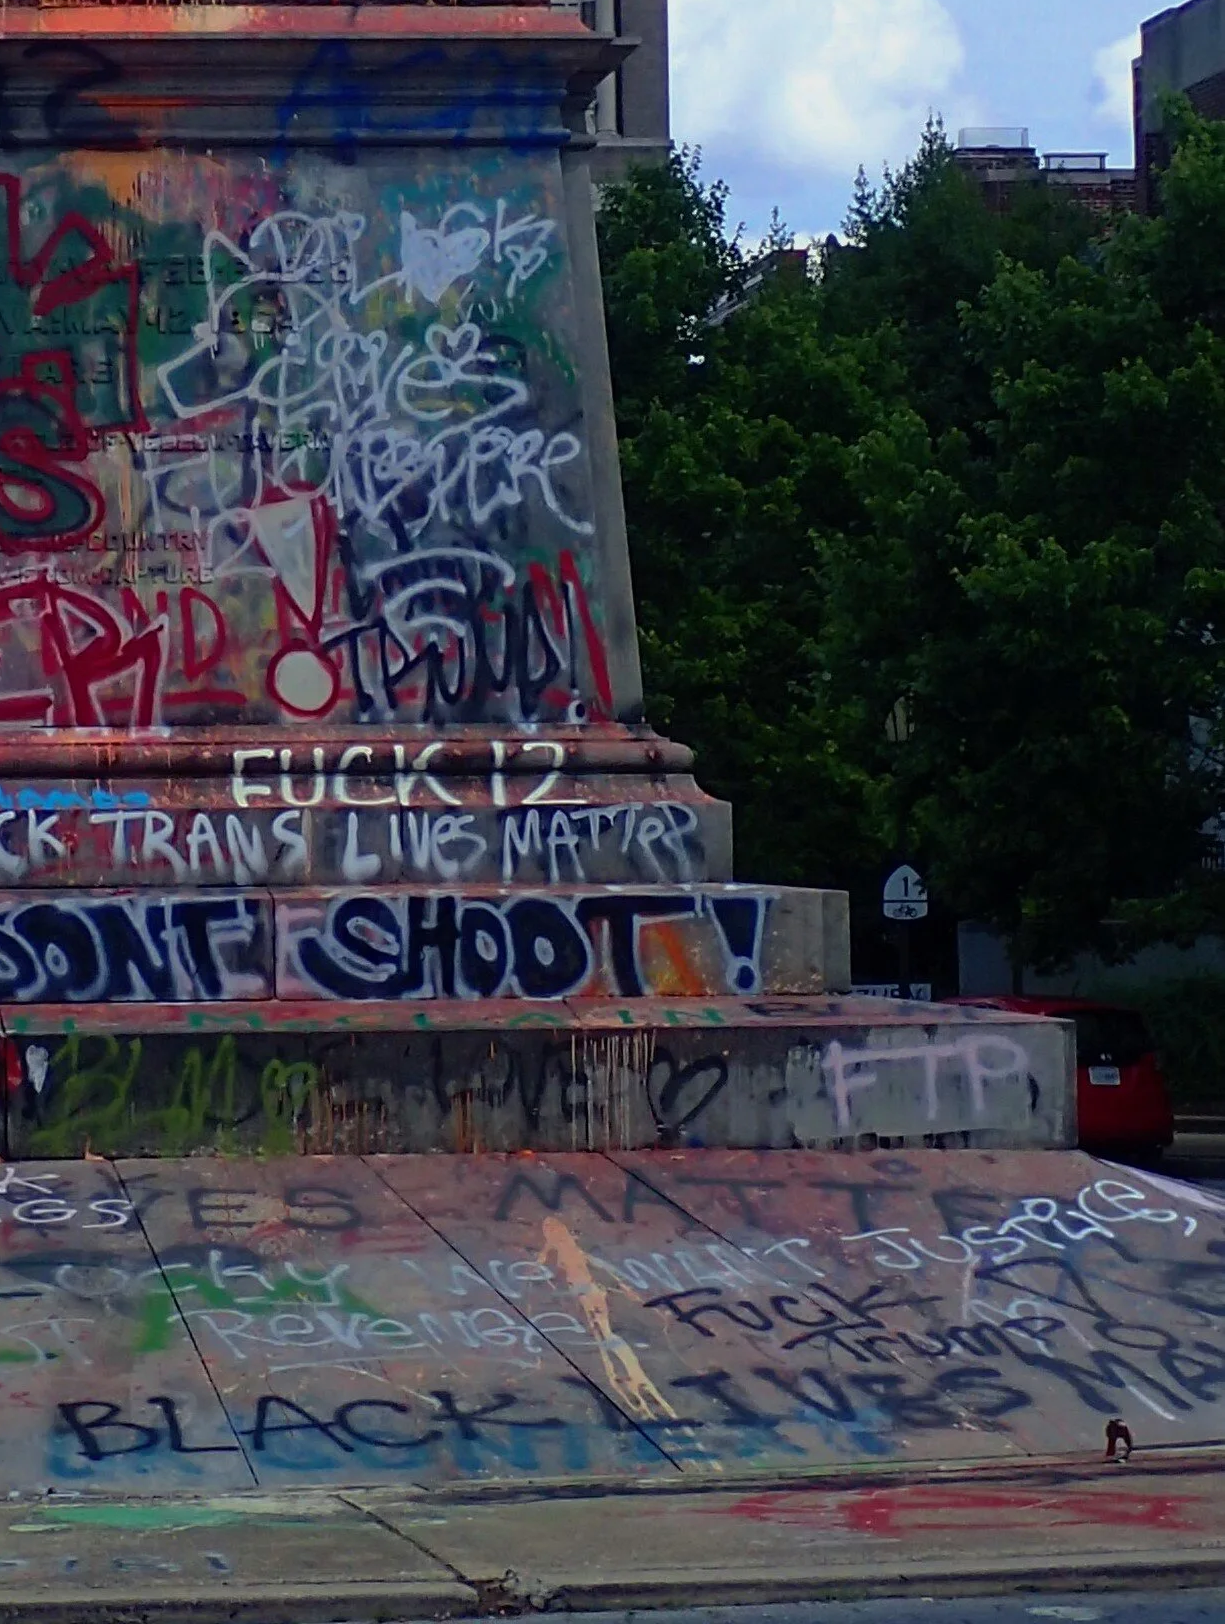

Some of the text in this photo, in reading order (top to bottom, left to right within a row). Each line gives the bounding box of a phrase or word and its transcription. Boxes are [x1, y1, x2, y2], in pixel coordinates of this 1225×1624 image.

[231, 740, 586, 808] FUCK 12
[91, 808, 309, 886] TRANS
[294, 893, 769, 1000] SHOOT!
[821, 1031, 1030, 1131] FTP
